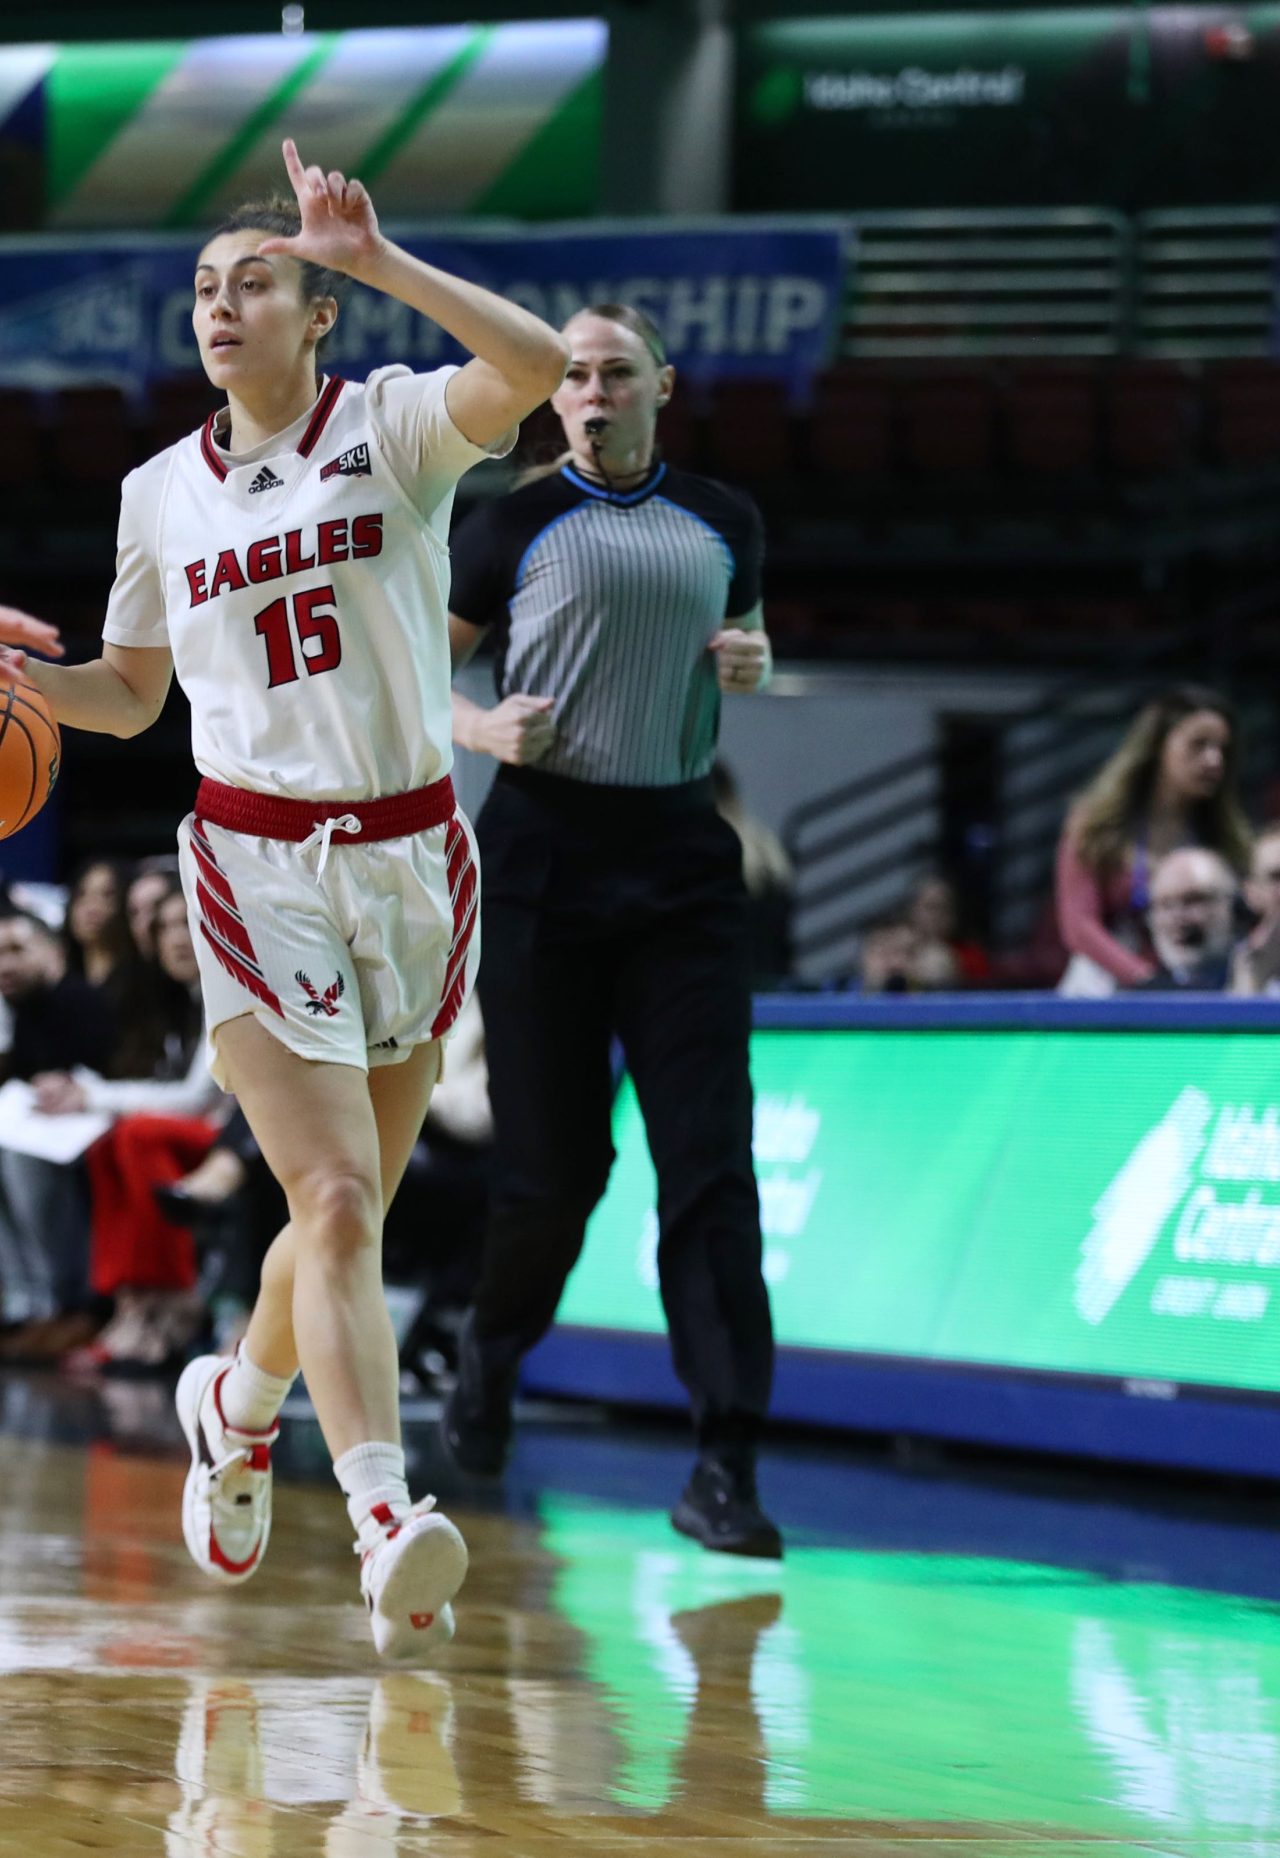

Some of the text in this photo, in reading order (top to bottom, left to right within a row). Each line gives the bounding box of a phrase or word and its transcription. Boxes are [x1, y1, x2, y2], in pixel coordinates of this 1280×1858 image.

[248, 478, 285, 494] adidas
[339, 445, 368, 471] SKY
[184, 513, 383, 608] EAGLES
[254, 584, 342, 689] 15
